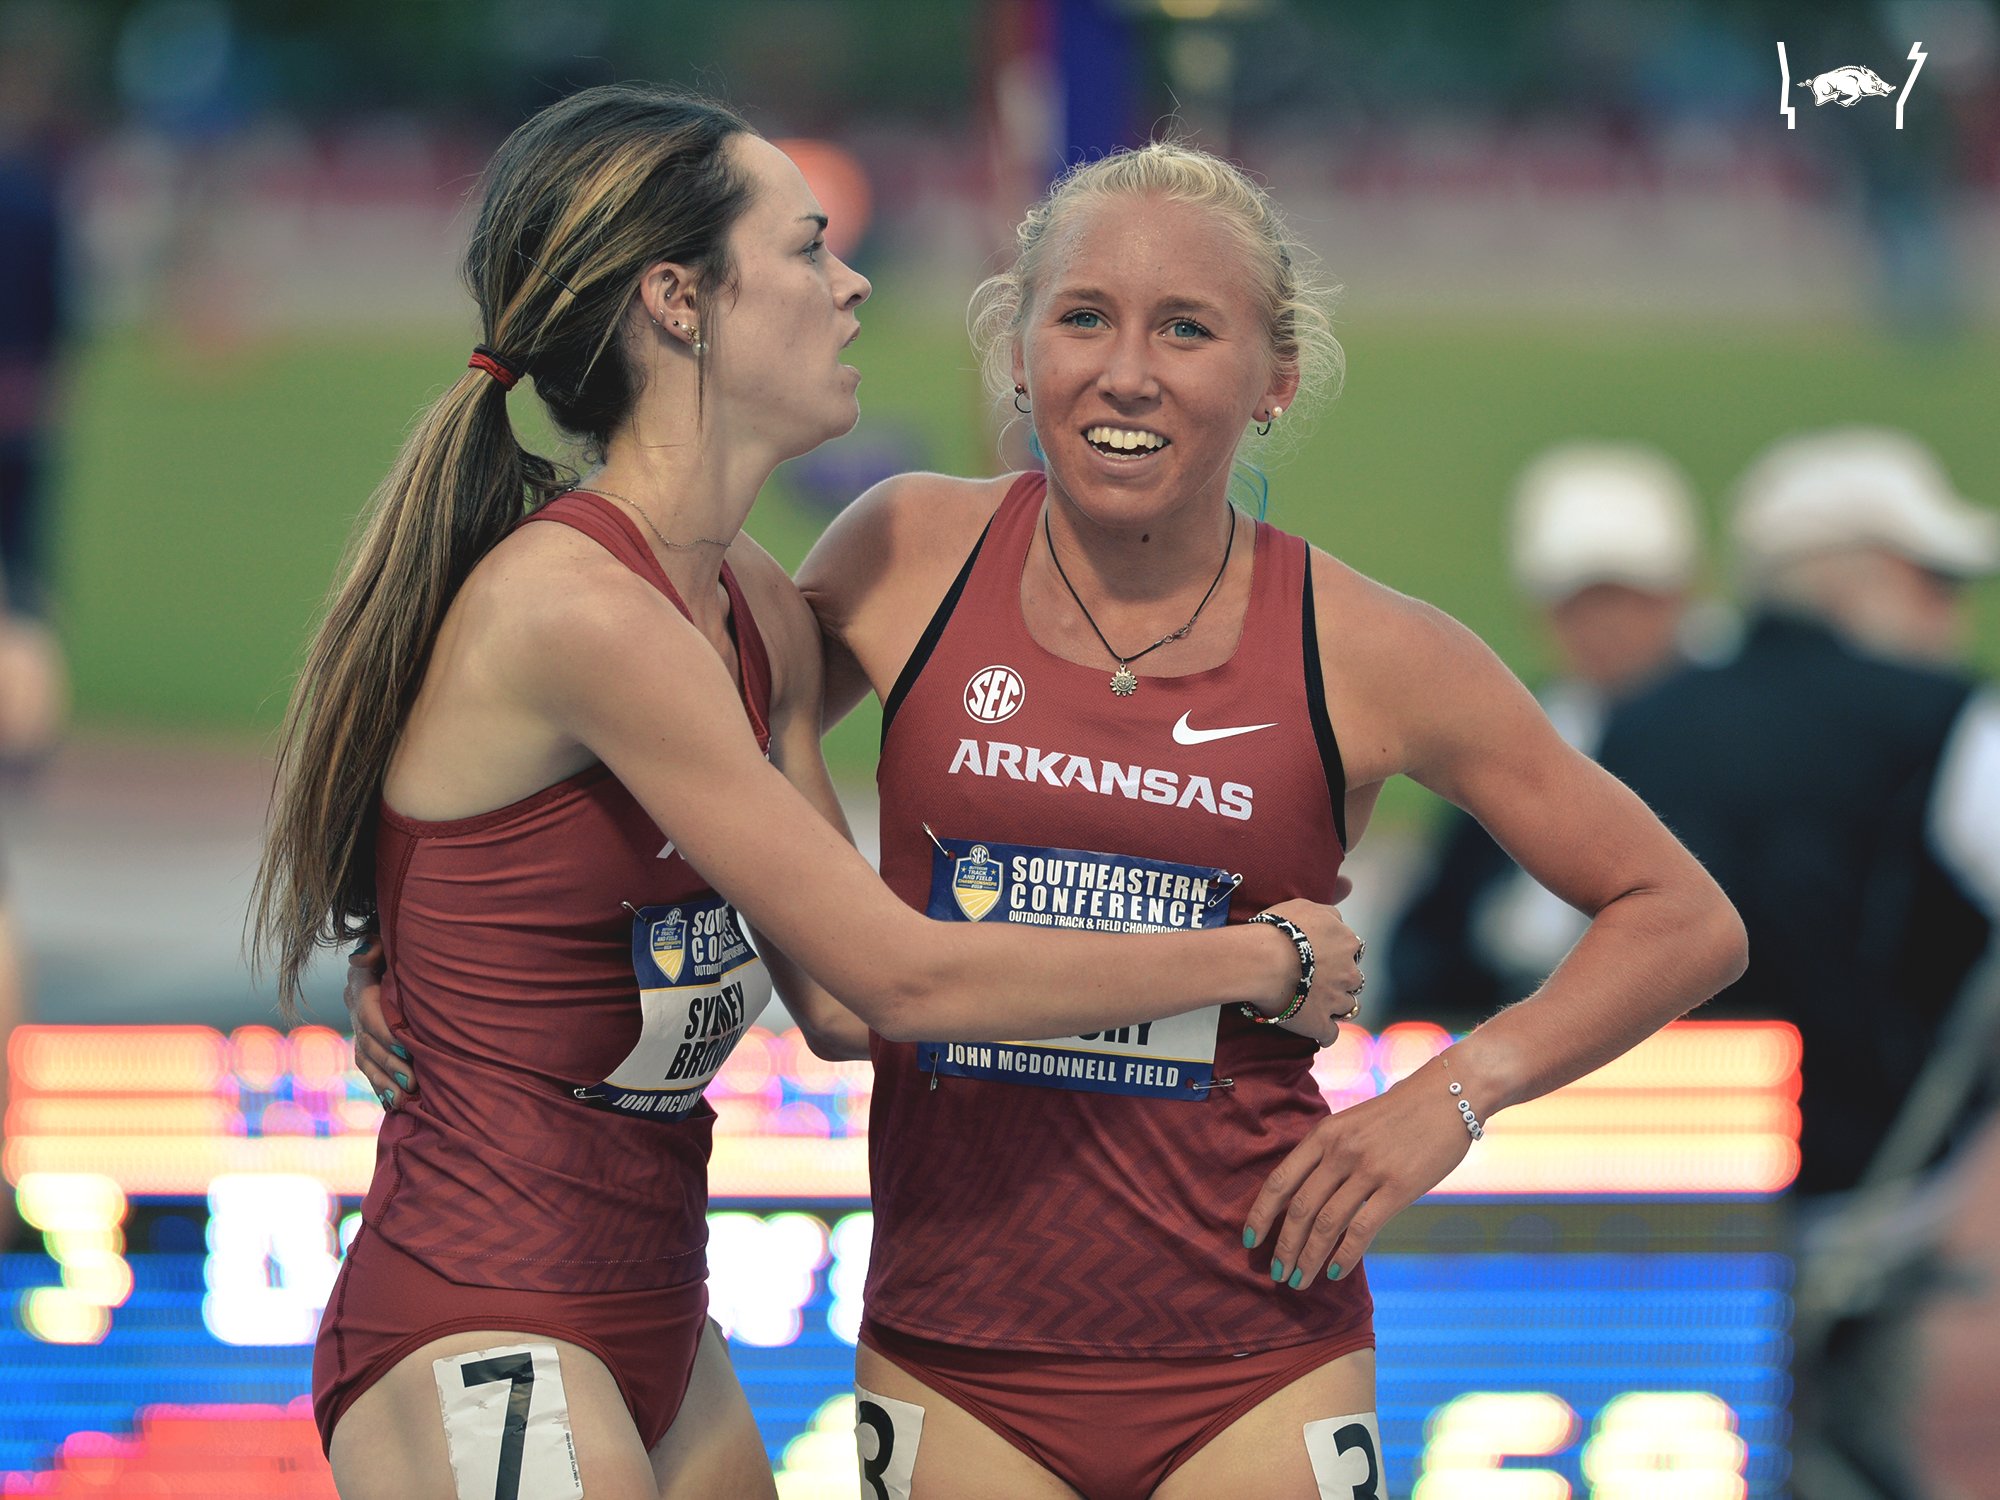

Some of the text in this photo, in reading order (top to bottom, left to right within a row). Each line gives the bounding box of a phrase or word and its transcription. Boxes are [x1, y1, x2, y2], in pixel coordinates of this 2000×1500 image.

[967, 669, 1021, 720] SEC
[948, 738, 1254, 821] ARKANSAS
[971, 846, 987, 864] SEC
[1012, 856, 1209, 903] SOUTHEASTERN
[1009, 910, 1053, 926] OUTDOOR
[1054, 915, 1085, 929] TRACK
[1086, 919, 1094, 930] &
[1096, 919, 1121, 932] FIELD
[1010, 883, 1204, 929] CONFERENCE
[946, 1043, 1179, 1087] JOHN MCDONNELL FIELD
[612, 1093, 657, 1112] JOHN
[461, 1352, 534, 1500] 7
